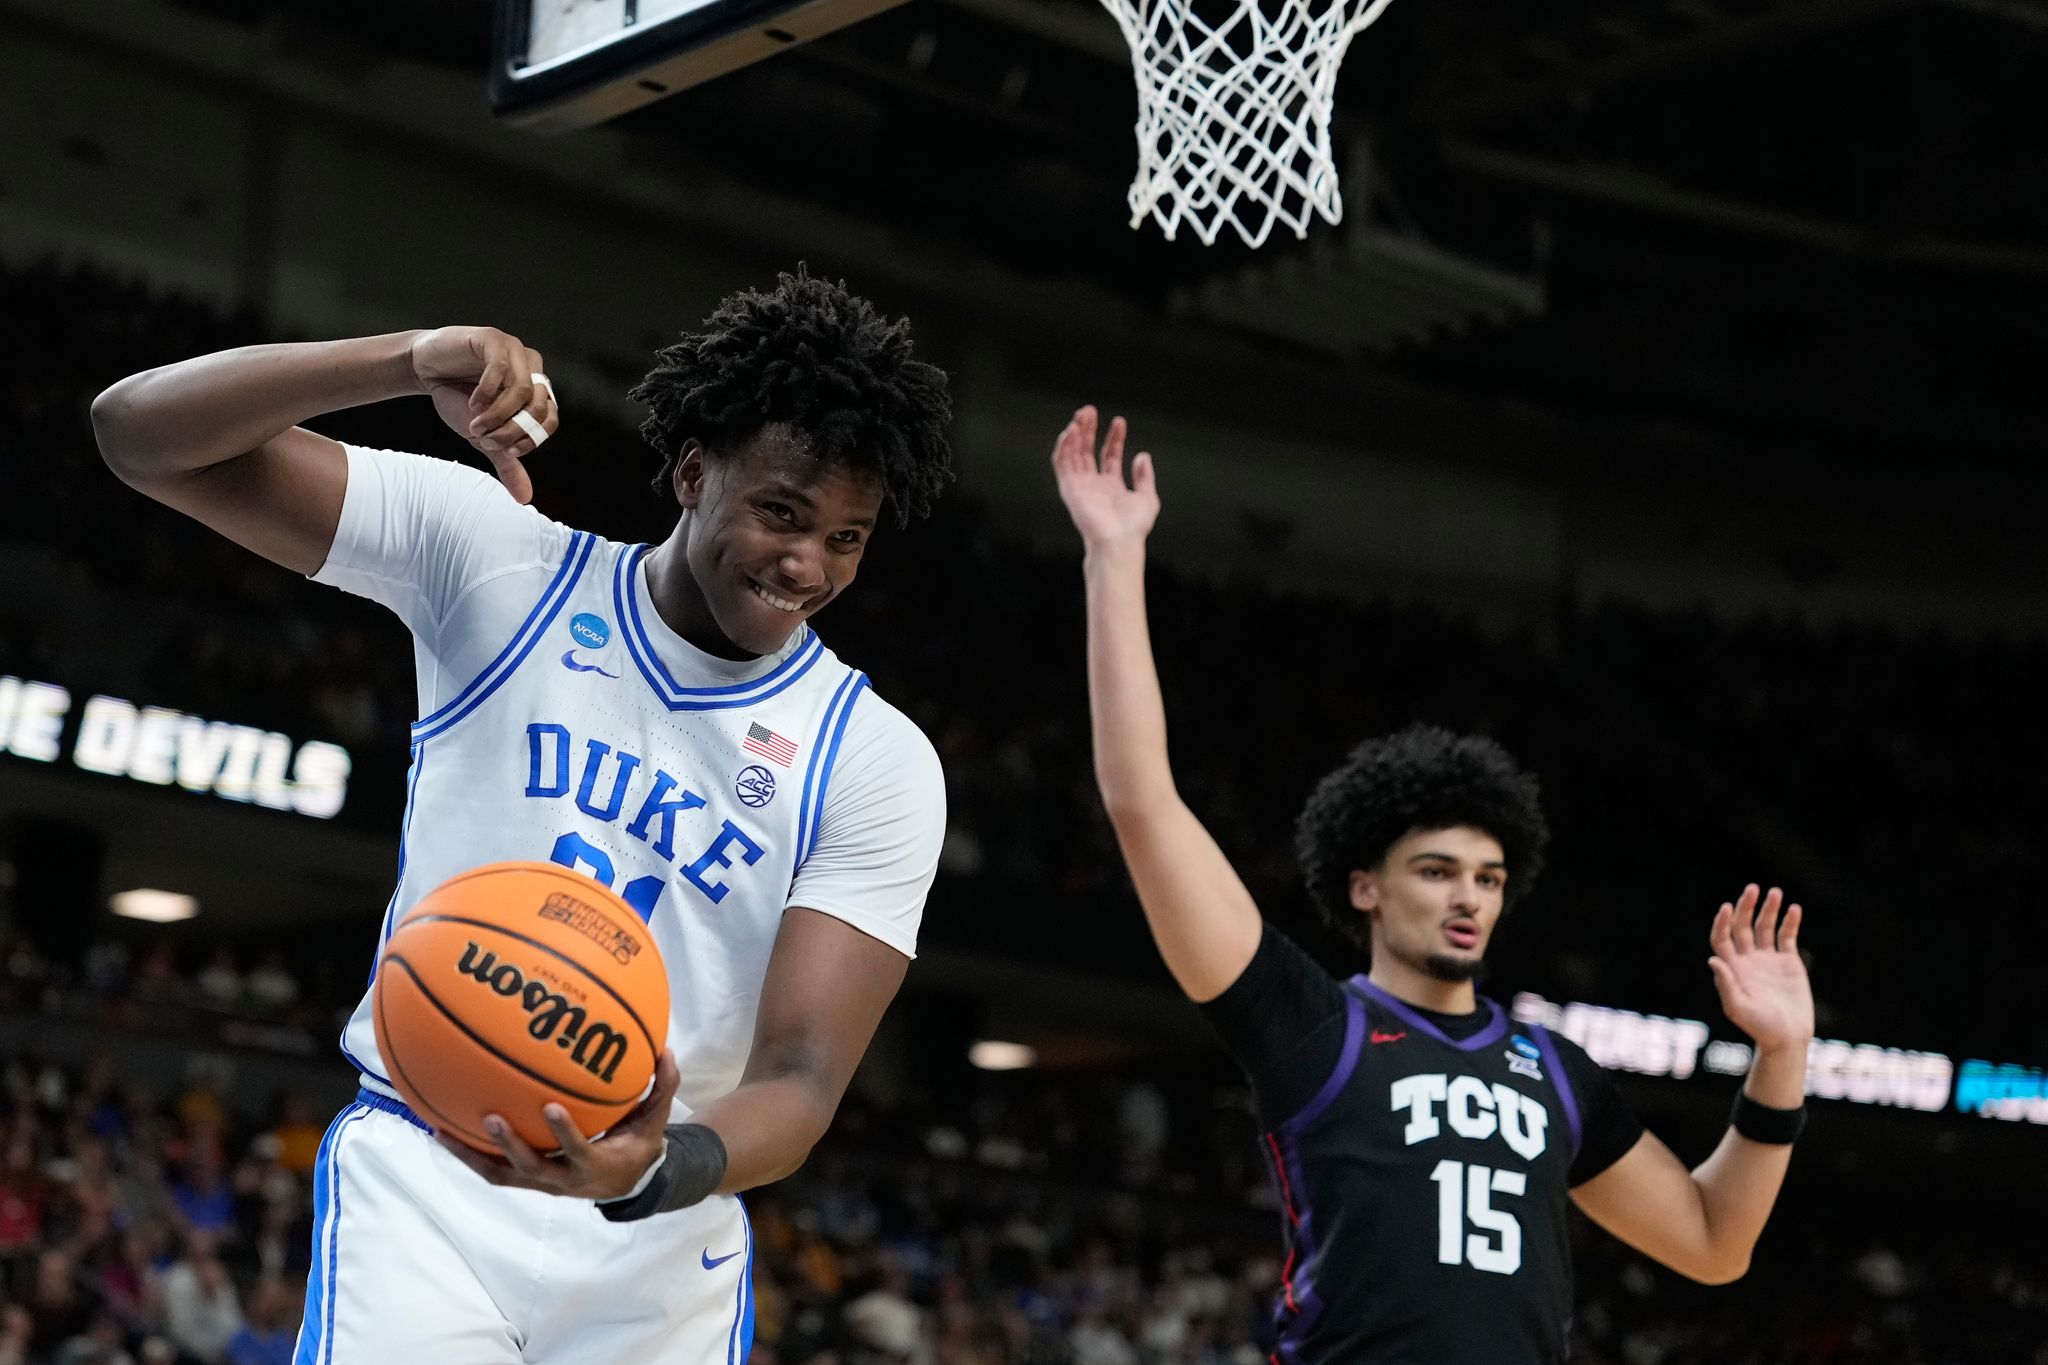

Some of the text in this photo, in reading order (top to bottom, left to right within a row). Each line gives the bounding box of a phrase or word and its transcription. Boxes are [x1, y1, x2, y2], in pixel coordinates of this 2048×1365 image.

[573, 622, 605, 645] NCAA
[73, 694, 351, 819] DEVILS
[525, 723, 765, 904] DUKE
[741, 778, 775, 795] ACC
[457, 941, 628, 1084] Wilson
[1391, 1073, 1548, 1161] TCU
[1430, 1159, 1527, 1275] 15
